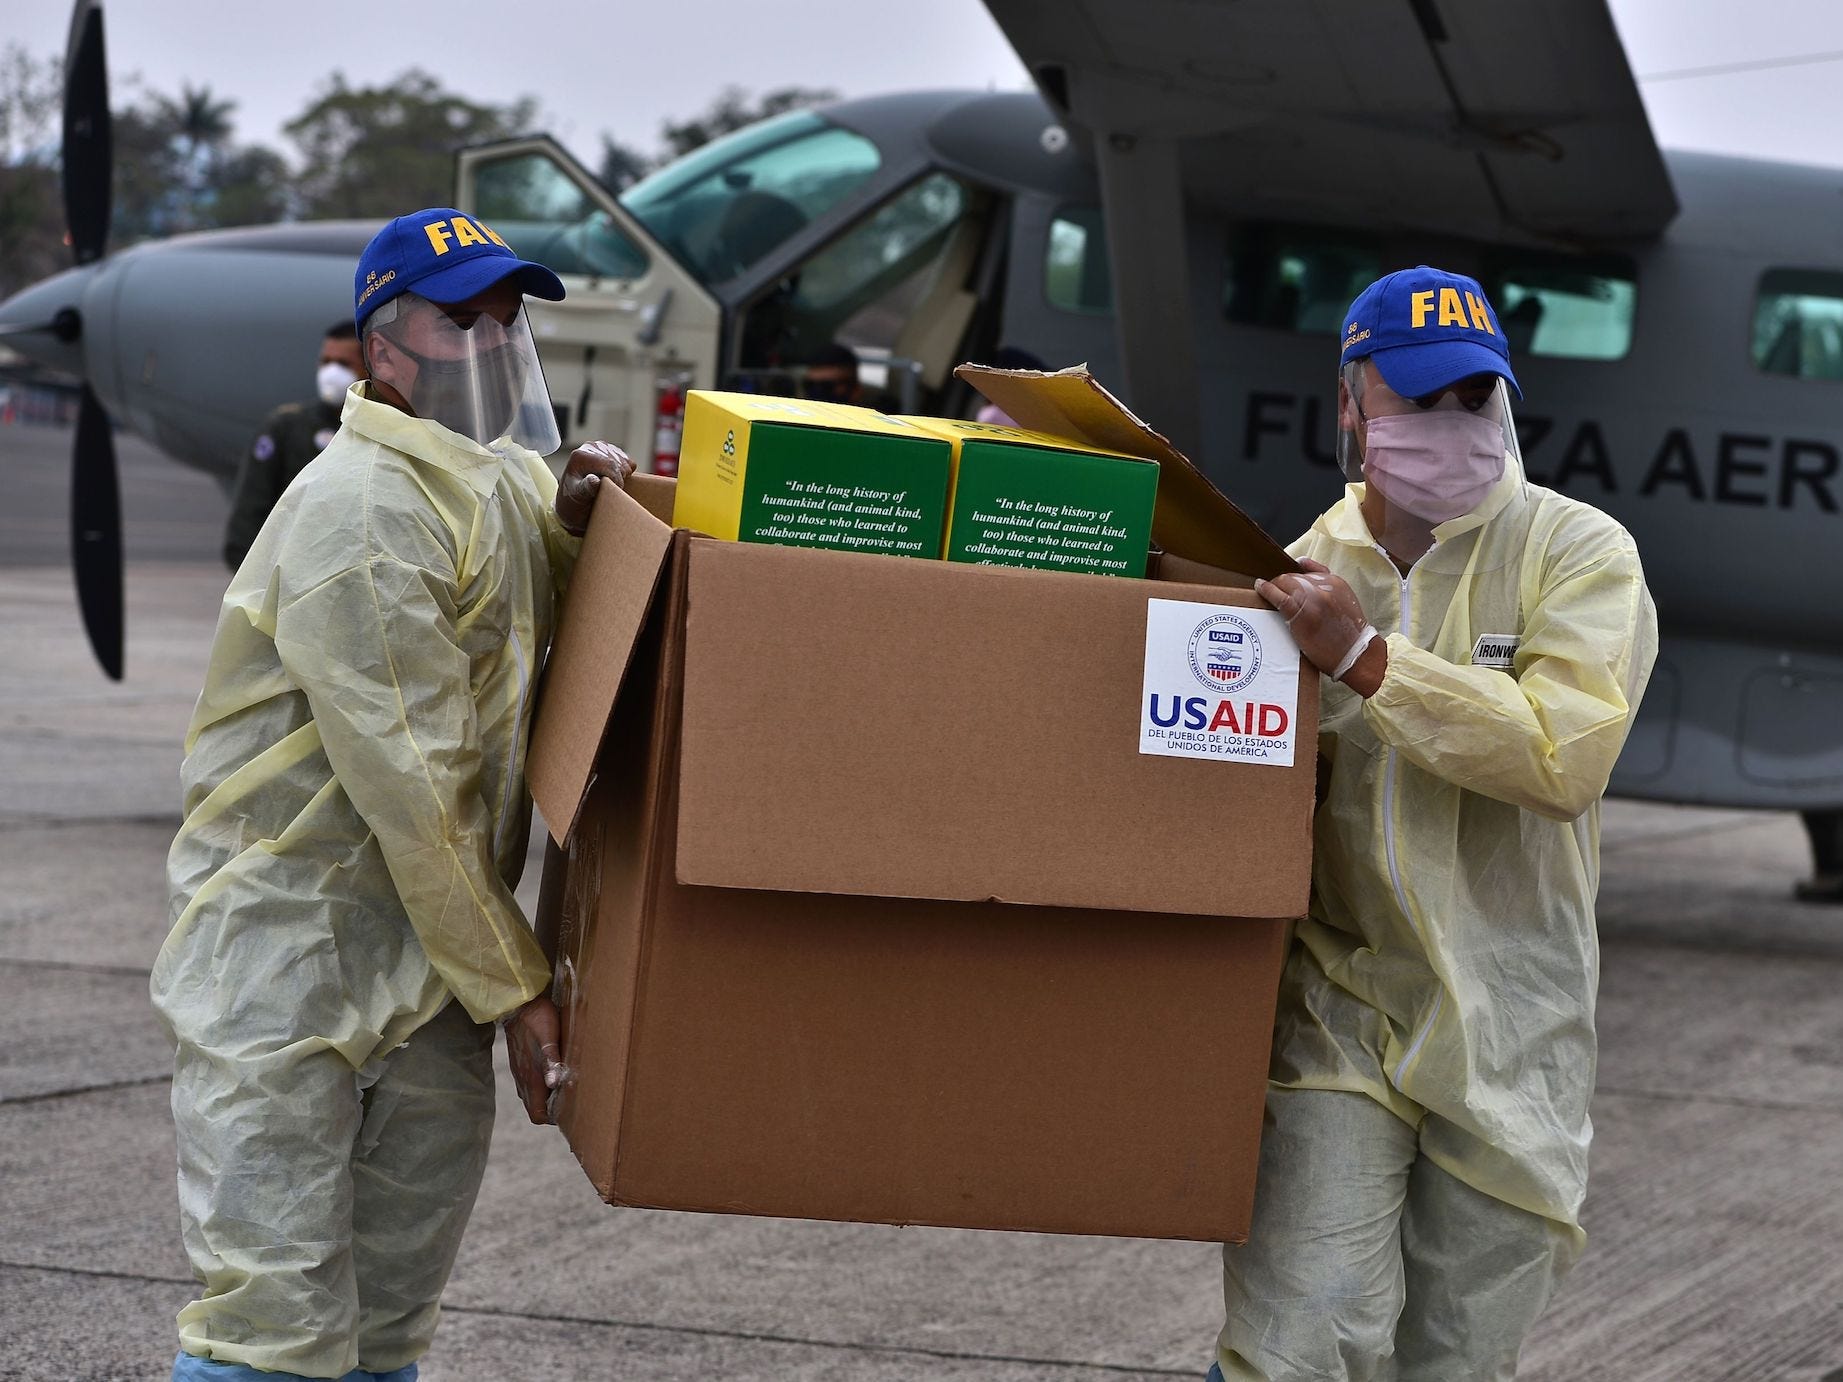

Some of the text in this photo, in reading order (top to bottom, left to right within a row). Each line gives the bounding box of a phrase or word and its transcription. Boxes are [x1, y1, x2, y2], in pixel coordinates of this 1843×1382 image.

[1411, 288, 1495, 336] FAH
[1244, 391, 1617, 493] FUZA
[806, 482, 824, 494] the
[826, 484, 851, 498] long
[853, 486, 891, 502] history
[892, 491, 907, 503] of
[762, 494, 921, 520] humankind (and animal kind,
[1016, 500, 1034, 512] the
[1035, 502, 1058, 517] long
[1061, 505, 1098, 521] history
[1099, 510, 1114, 522] of
[772, 512, 908, 533] too) those who learned to
[972, 511, 1127, 540] humankind (and animal kind,
[755, 526, 922, 550] collaborate and improvise most
[982, 530, 1114, 552] too) those who learned to
[964, 542, 1128, 570] collaborate and improvise most
[1194, 616, 1259, 644] UNITED STATES AGENCY
[1212, 632, 1240, 642] USAID
[1189, 650, 1260, 692] INTERNATIONAL DEVELOPMENT
[1150, 693, 1289, 737] USAID
[1148, 729, 1288, 750] DEL PUEBLO DE LOS ESTADOS
[1168, 741, 1268, 757] UNIDOS DE AMÉRICA
